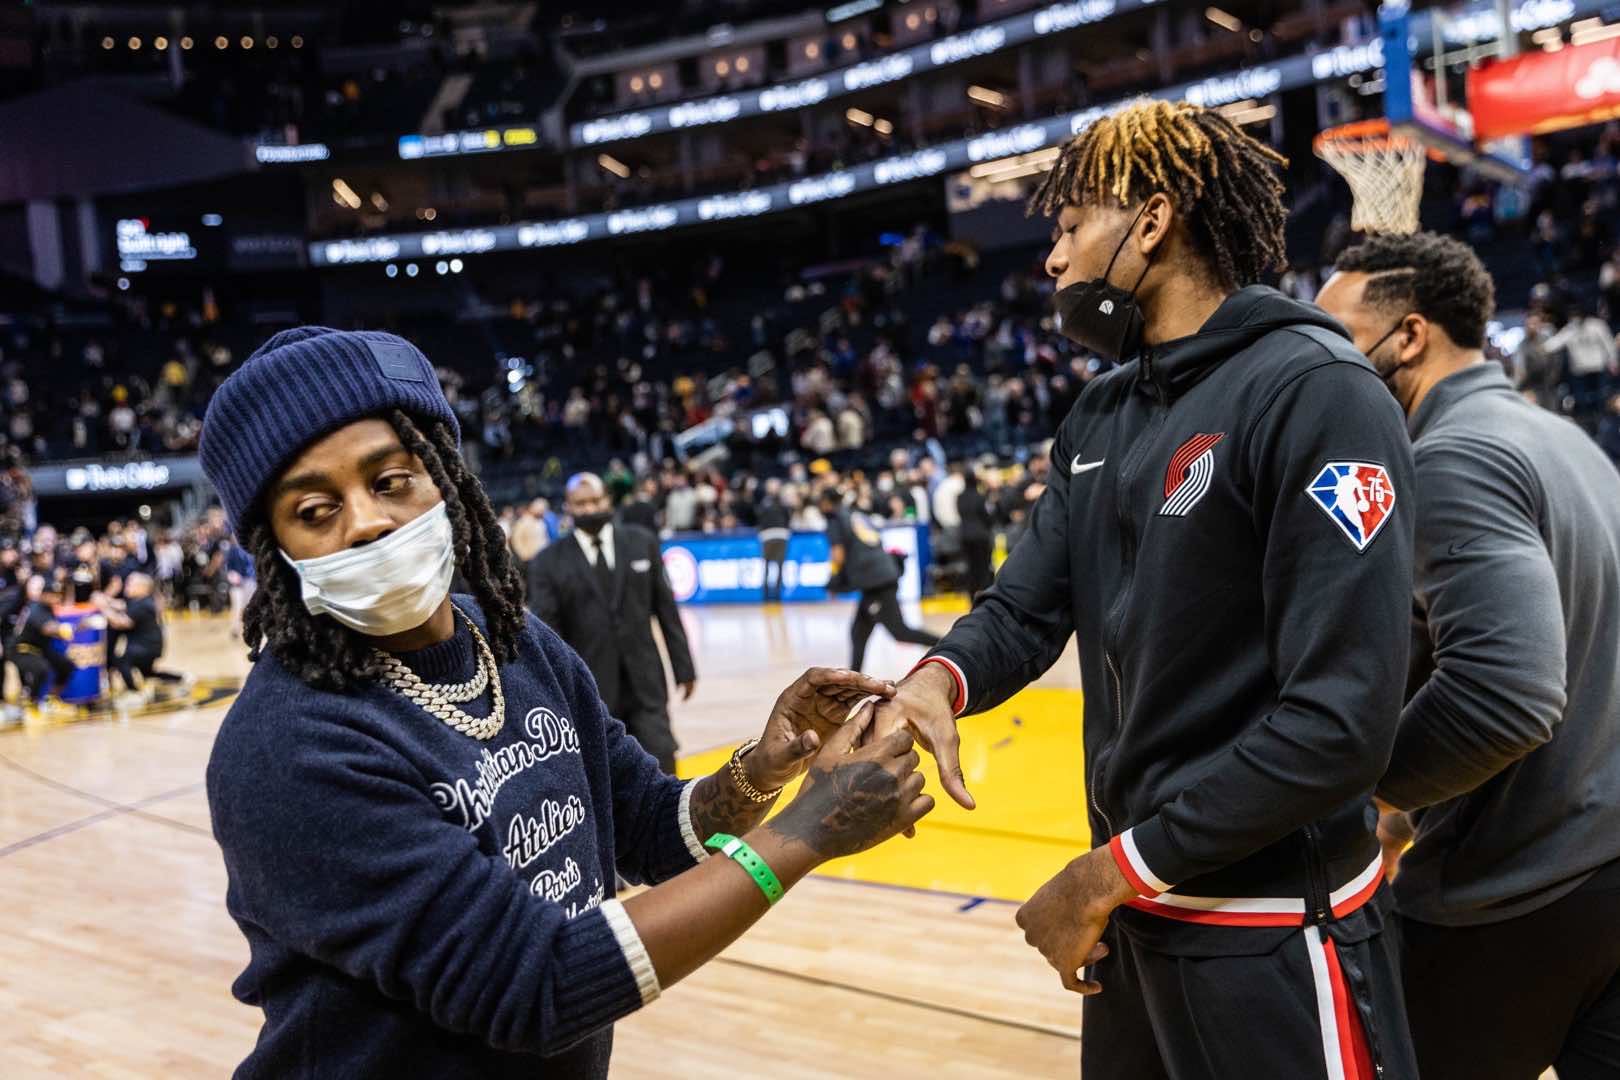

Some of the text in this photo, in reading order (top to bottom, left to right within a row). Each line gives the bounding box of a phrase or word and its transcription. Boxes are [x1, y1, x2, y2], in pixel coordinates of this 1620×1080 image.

[1367, 476, 1385, 503] 75
[503, 795, 585, 868] Atelier
[530, 857, 581, 902] Paris
